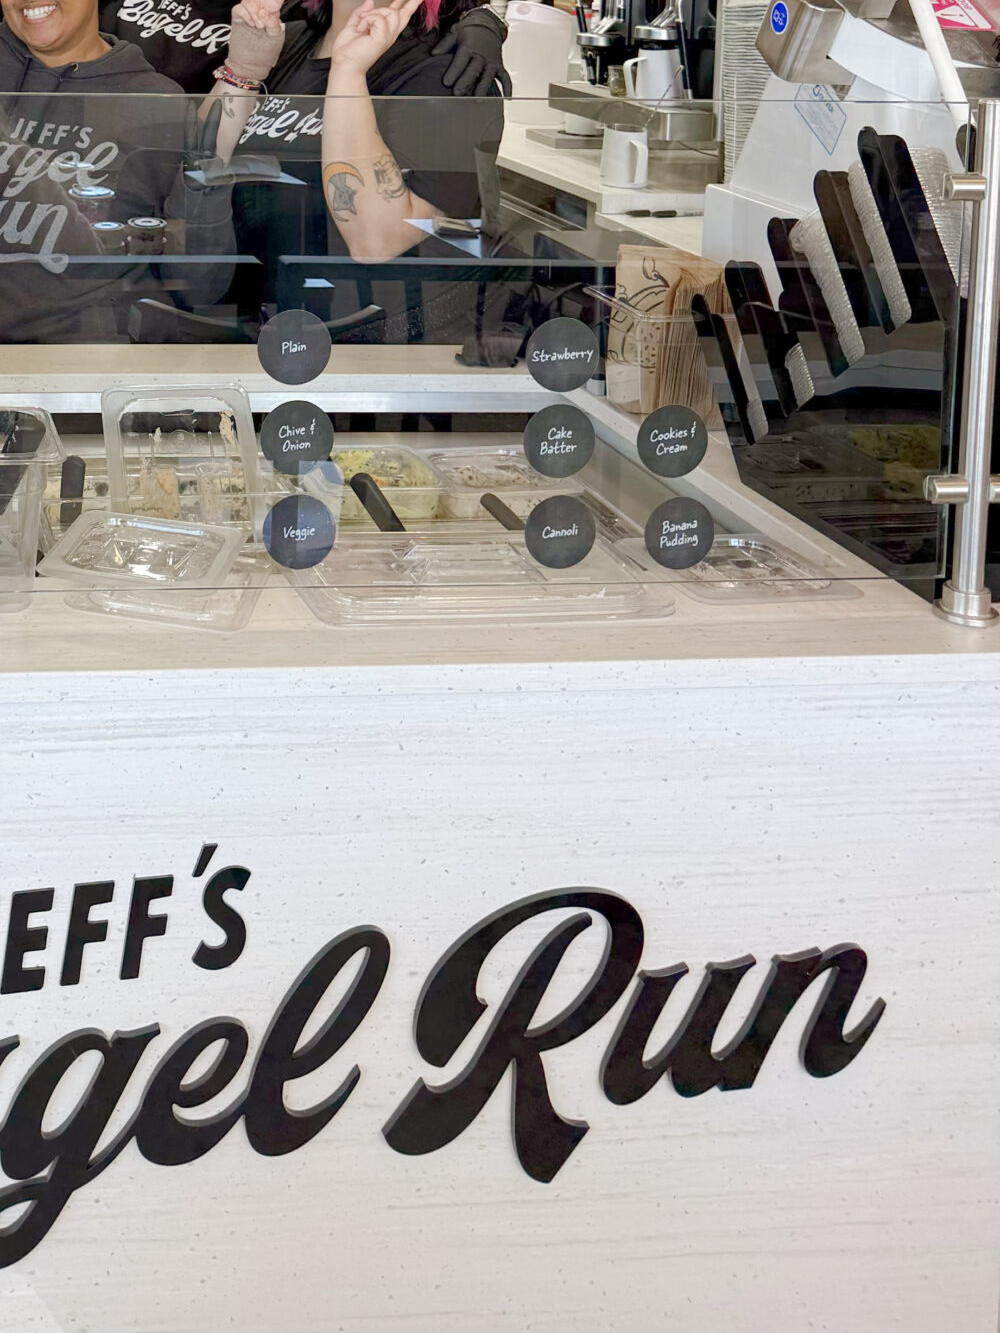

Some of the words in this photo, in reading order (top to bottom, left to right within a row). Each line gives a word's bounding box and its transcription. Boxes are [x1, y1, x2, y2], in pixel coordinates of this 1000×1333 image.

[10, 118, 93, 149] JEFF'S
[282, 341, 306, 355] Plain
[532, 348, 594, 363] Strawberry
[278, 423, 306, 439] Chive
[548, 427, 573, 441] Cake
[650, 426, 688, 442] Cookies
[283, 439, 311, 452] Onion
[540, 440, 577, 454] Batter
[656, 441, 688, 453] Cream
[283, 524, 315, 542] Veggie
[542, 524, 578, 539] Cannoli
[662, 518, 698, 533] Banana
[659, 532, 698, 548] Pudding
[381, 886, 887, 1183] Run
